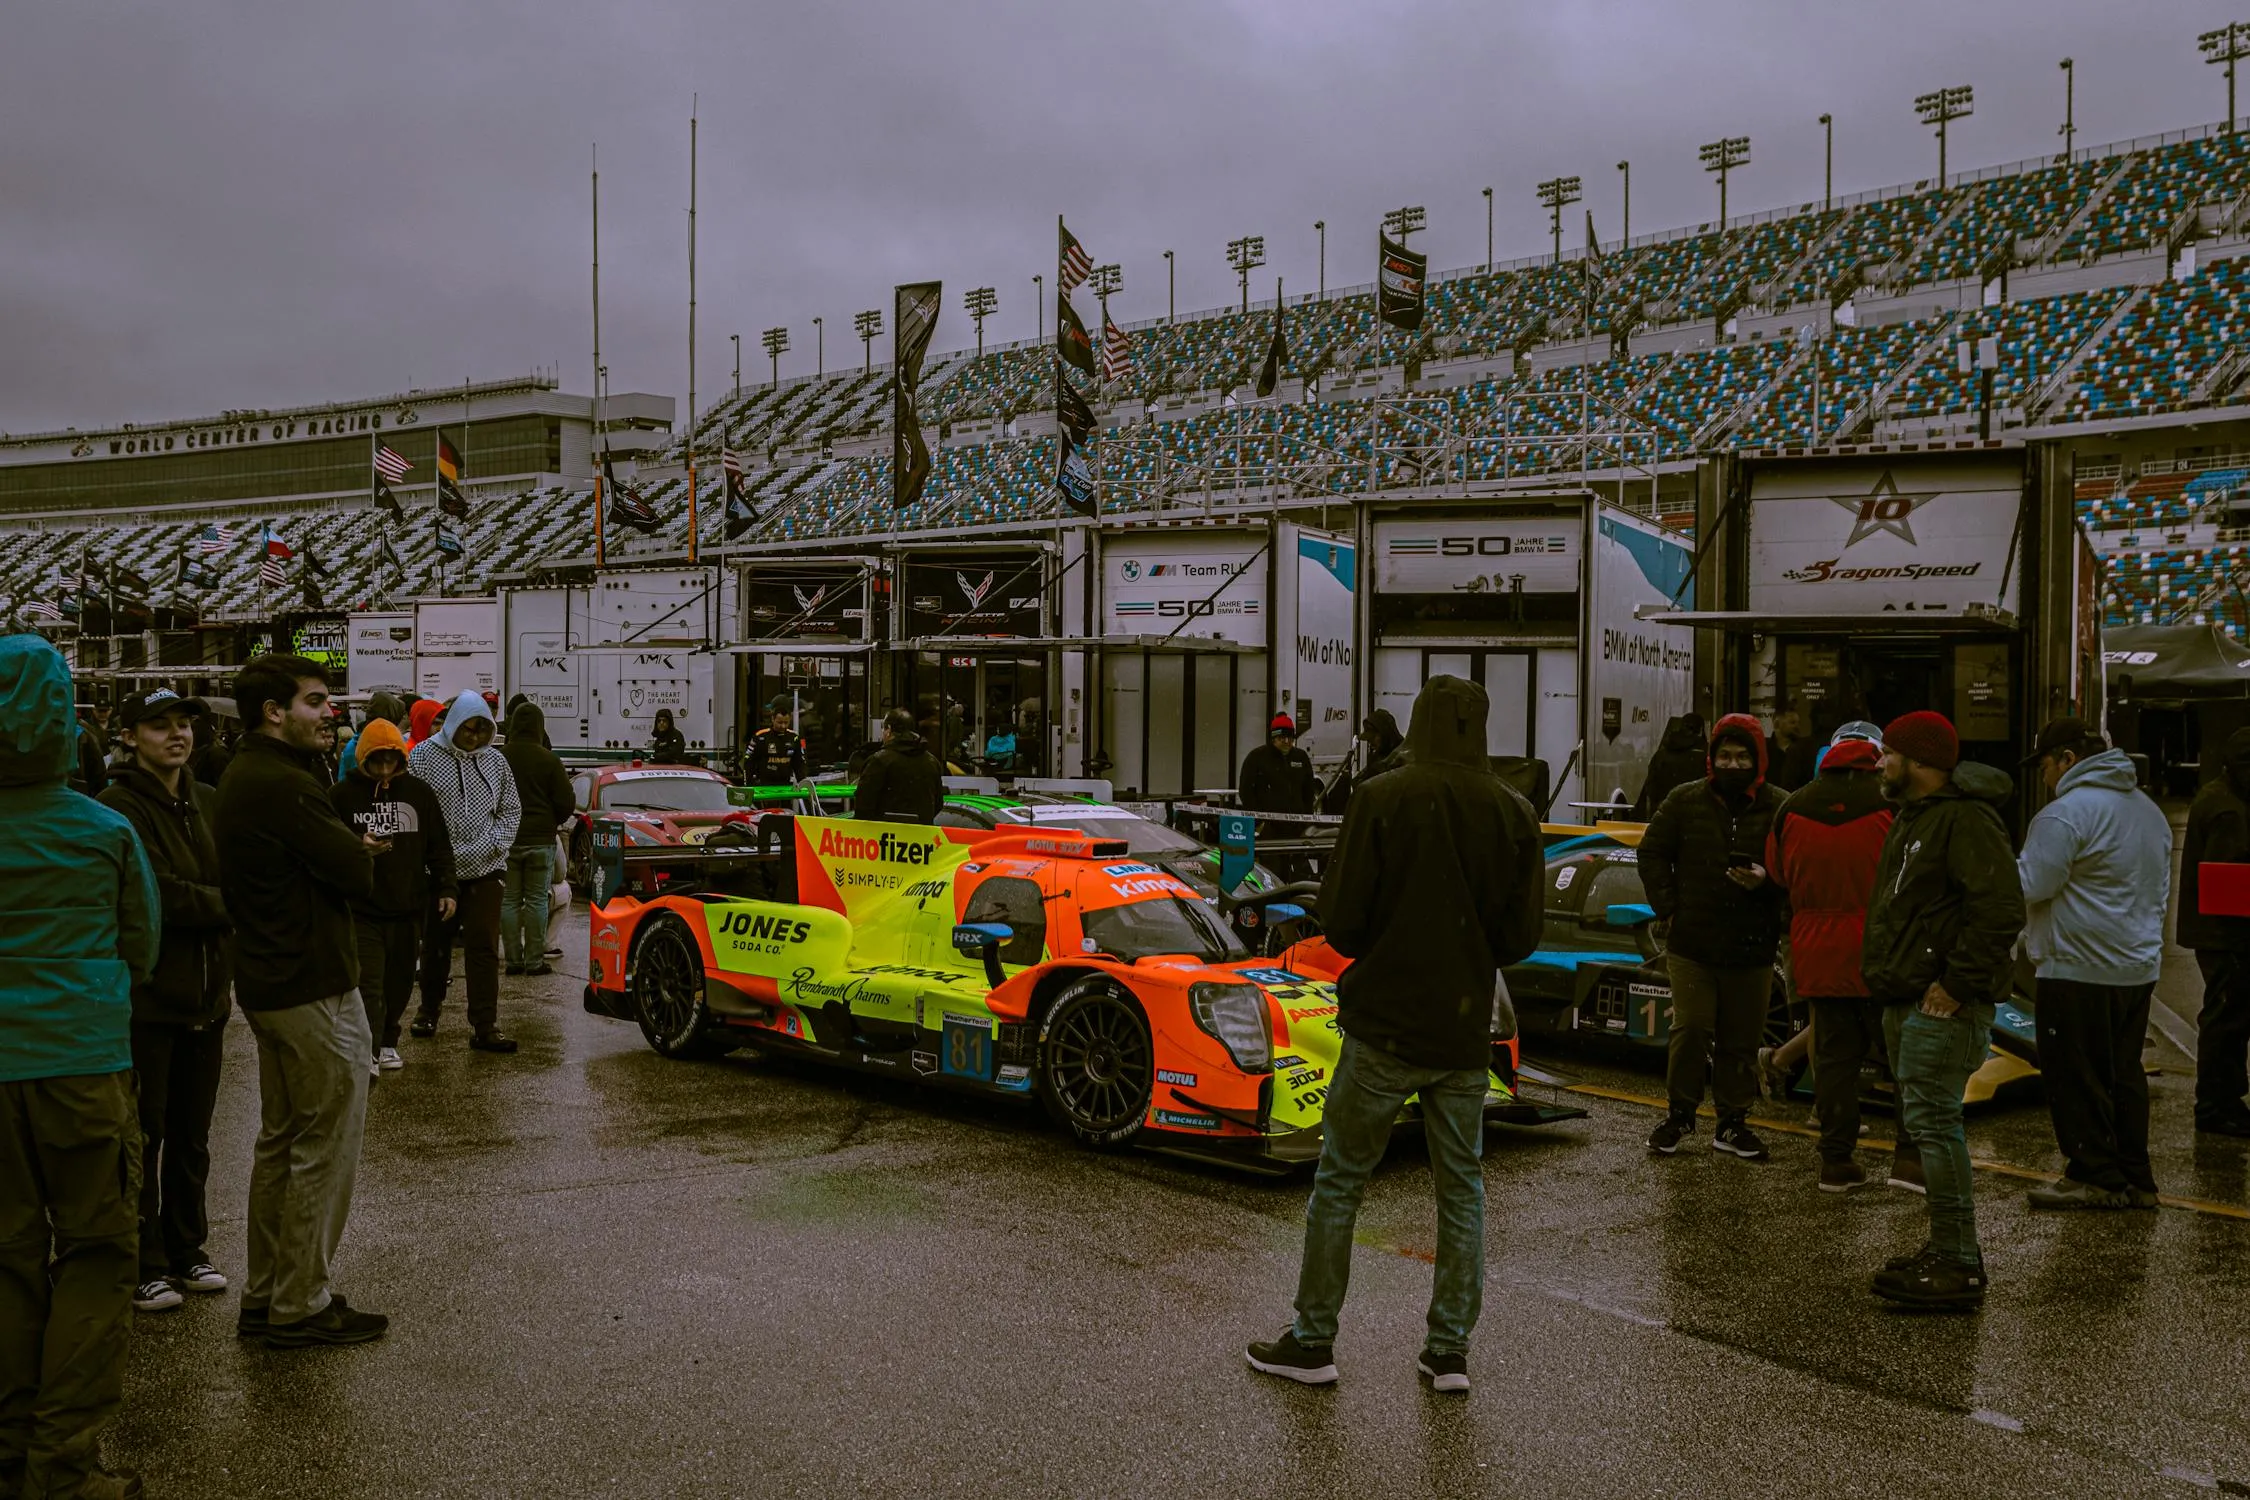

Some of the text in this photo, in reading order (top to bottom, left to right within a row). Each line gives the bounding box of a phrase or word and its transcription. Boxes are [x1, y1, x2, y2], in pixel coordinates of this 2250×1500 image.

[110, 414, 382, 455] WORLD CENTER OF RACING
[1856, 499, 1912, 521] 10
[1442, 536, 1511, 555] 50
[1514, 537, 1545, 545] JAHRE
[1537, 545, 1545, 553] M
[1182, 564, 1217, 576] Team
[1220, 563, 1247, 576] RLL
[1158, 600, 1214, 616] 50
[1217, 600, 1242, 608] JAHRE
[1297, 634, 1319, 663] MW
[1321, 638, 1333, 664] of
[1604, 628, 1691, 671] BMW of North America
[530, 657, 568, 672] AMR
[633, 655, 675, 669] AMR
[372, 801, 397, 812] THE
[353, 812, 399, 824] NORTH
[367, 823, 399, 833] FACE
[818, 828, 934, 865] Atmofizer
[1025, 840, 1056, 852] MOTUL
[719, 912, 812, 943] JONES
[732, 940, 782, 955] SODA CO.
[785, 967, 892, 1005] Rembrandt Charms
[1631, 985, 1671, 996] Weather
[944, 1013, 991, 1027] WeatherTech
[951, 1027, 983, 1074] 81
[1157, 1071, 1197, 1087] MOTUL
[1286, 1067, 1325, 1091] 300V
[1168, 1116, 1216, 1127] MICHELIN
